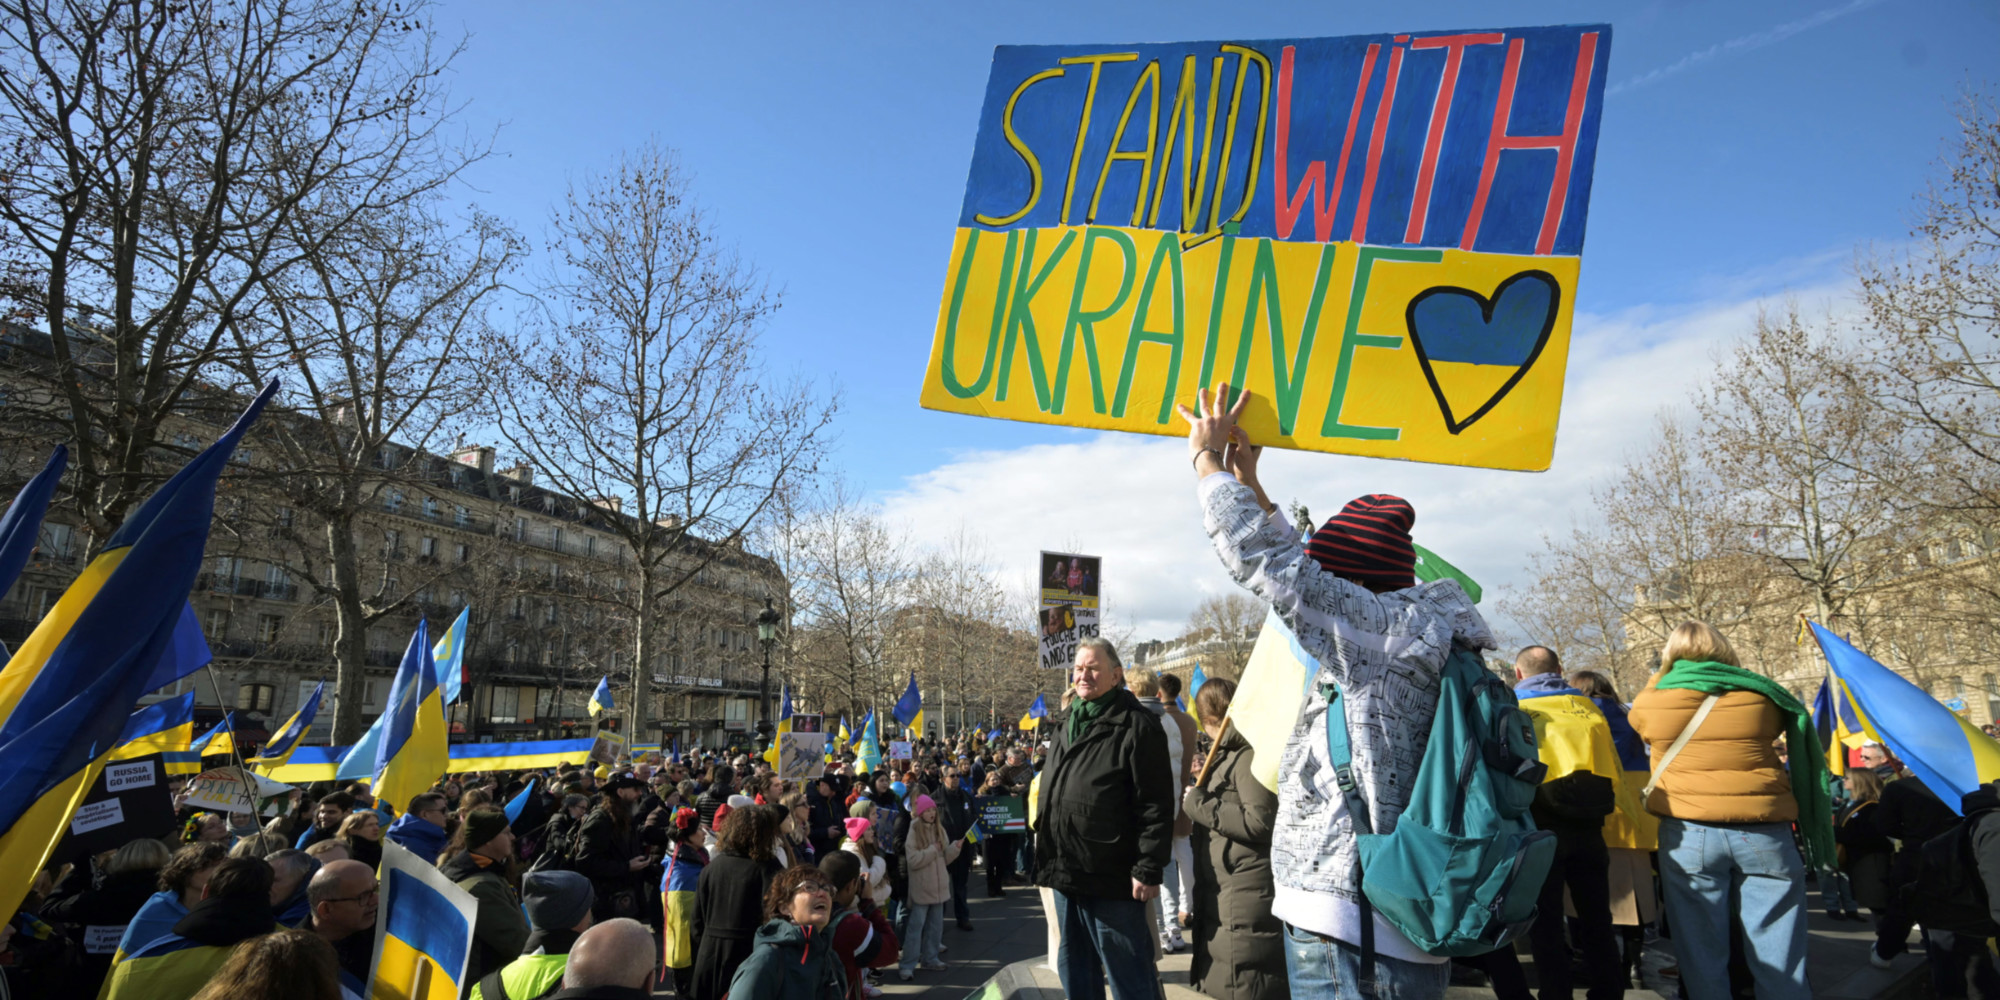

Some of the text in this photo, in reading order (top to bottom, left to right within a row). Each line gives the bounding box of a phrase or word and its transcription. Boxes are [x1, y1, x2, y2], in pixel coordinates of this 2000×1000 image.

[975, 32, 1599, 256] STAND WITH
[940, 220, 1443, 441] UKRAINE
[1042, 623, 1100, 649] TOUCHE PAS
[675, 675, 697, 687] STREET
[698, 677, 722, 688] ENGLISH
[109, 773, 152, 787] GO HOME
[113, 765, 148, 777] RUSSIA
